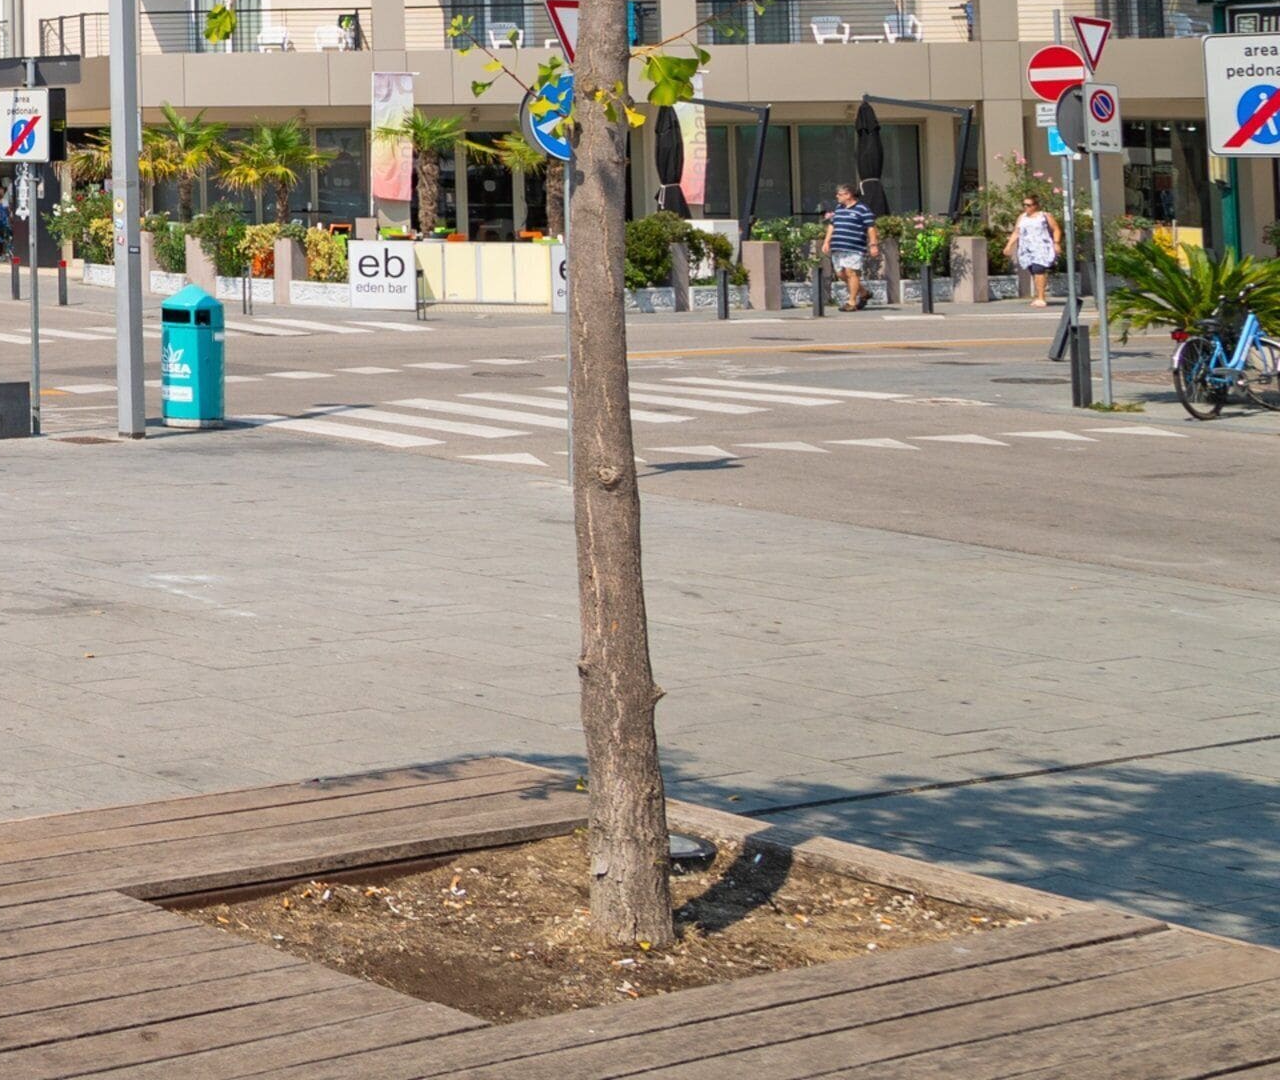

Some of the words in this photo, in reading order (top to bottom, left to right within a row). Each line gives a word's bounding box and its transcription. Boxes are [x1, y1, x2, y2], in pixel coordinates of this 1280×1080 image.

[1244, 45, 1279, 57] area
[14, 96, 30, 104] area
[6, 106, 39, 116] pedonale
[358, 247, 406, 279] eb
[355, 282, 385, 293] eden
[388, 282, 408, 294] bar
